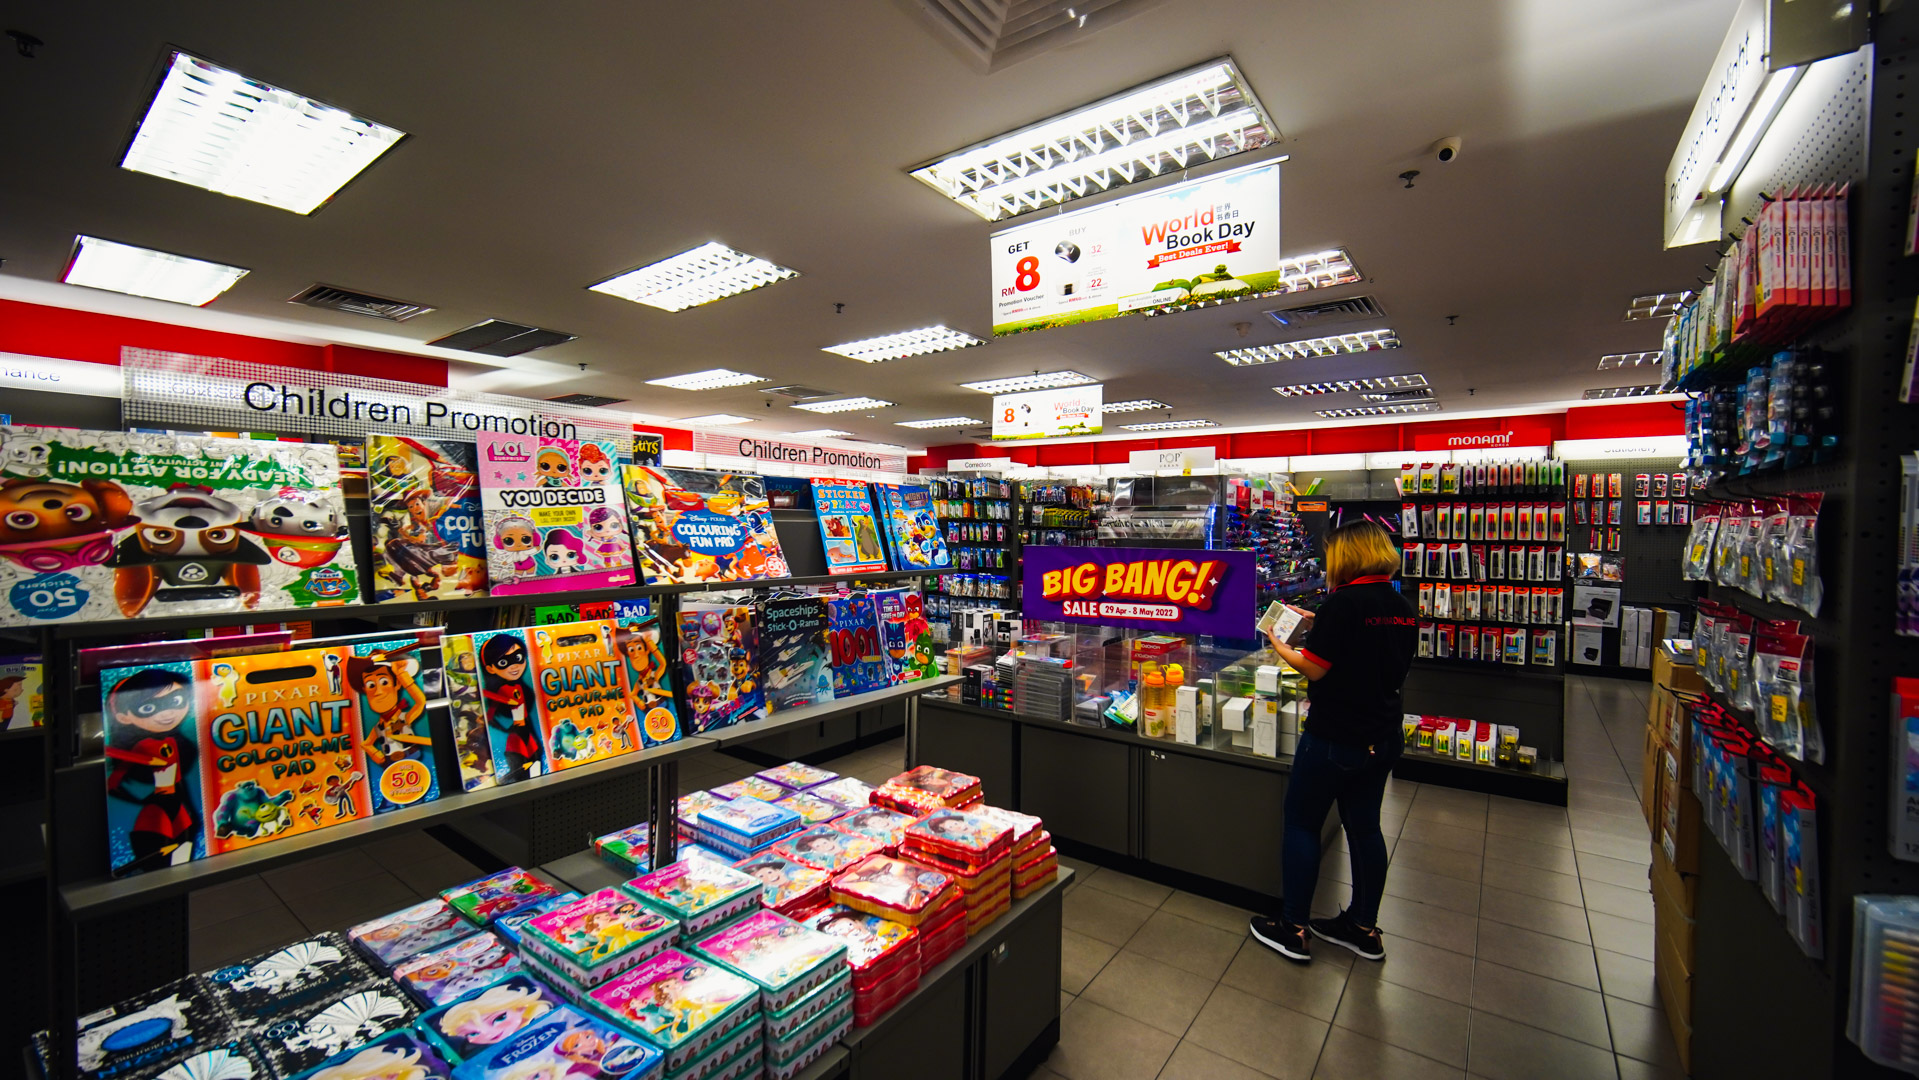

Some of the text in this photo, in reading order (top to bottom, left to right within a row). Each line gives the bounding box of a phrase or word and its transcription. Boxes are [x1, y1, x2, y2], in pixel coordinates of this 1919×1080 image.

[1706, 29, 1750, 133] Highlight
[1069, 227, 1087, 236] BUY
[1141, 204, 1214, 246] World
[1166, 221, 1256, 250] Book Day
[1008, 241, 1030, 254] GET
[1091, 244, 1102, 254] 32
[1158, 242, 1229, 262] Best Deals Ever!
[1001, 255, 1041, 297] RM 8
[1091, 278, 1102, 288] 22
[998, 294, 1045, 308] Promotion Voucher
[1152, 296, 1172, 304] ONLINE
[243, 381, 412, 425] Children
[425, 401, 578, 441] Promotion
[1054, 399, 1081, 411] World
[1081, 406, 1095, 414] Day
[1003, 407, 1015, 423] 8
[1448, 430, 1514, 446] monami
[632, 440, 659, 454] GUYS
[738, 438, 881, 469] Children Promotion
[964, 461, 992, 469] Correctors
[1159, 452, 1181, 463] POP
[58, 460, 300, 483] READY FOR ACTION!
[501, 490, 542, 507] YOU
[545, 488, 604, 505] DECIDE
[817, 489, 866, 499] STICKER
[831, 500, 858, 509] PLAY
[688, 514, 707, 523] Disney
[678, 523, 742, 537] COLOURING
[462, 533, 484, 547] FU
[689, 536, 735, 548] FUN PAD
[303, 577, 353, 592] PAW
[1043, 560, 1213, 604] BIG BANG!
[29, 587, 77, 607] 50
[586, 609, 610, 620] BAD
[623, 605, 647, 618] BAD
[766, 604, 819, 621] Spaceships
[1063, 601, 1098, 616] SALE
[1105, 606, 1114, 614] 29
[1115, 606, 1127, 616] Apr
[1139, 607, 1154, 618] May
[1155, 608, 1174, 617] 2022
[547, 613, 574, 624] BAD
[767, 619, 820, 633] Stick-O-Rama
[839, 618, 865, 628] PIXAR
[829, 626, 881, 668] 1001
[557, 648, 601, 663] PIXAR
[540, 660, 620, 697] GIANT
[245, 684, 321, 706] PIXAR
[546, 687, 624, 712] COLOUR-ME
[579, 704, 604, 719] PAD
[210, 699, 351, 751] GIANT
[651, 716, 669, 729] 50
[216, 734, 353, 772] COLOUR-ME
[272, 758, 316, 780] PAD
[392, 771, 421, 788] 50
[547, 896, 617, 927] PRINCESS
[716, 919, 776, 950] PRINCESS
[611, 957, 682, 999] PRINCESS
[501, 1027, 558, 1064] FROZEN
